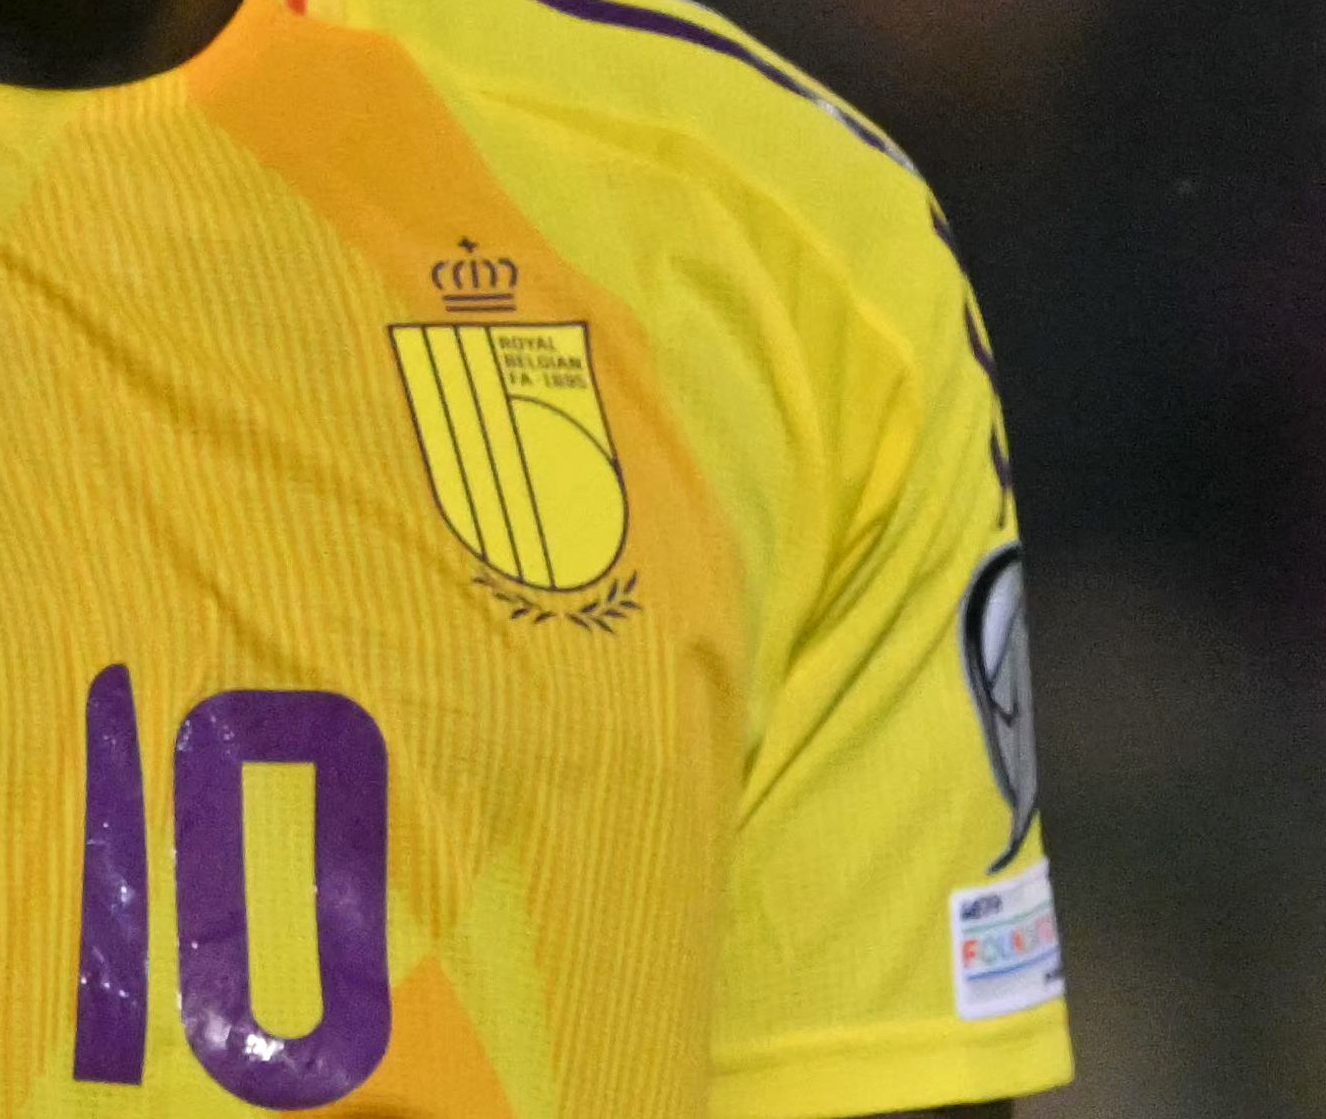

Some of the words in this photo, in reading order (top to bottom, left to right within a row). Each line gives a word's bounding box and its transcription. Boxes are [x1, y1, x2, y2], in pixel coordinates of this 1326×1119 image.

[499, 336, 556, 351] ROYAL
[504, 352, 582, 370] BELGIAN
[73, 663, 392, 1111] 10
